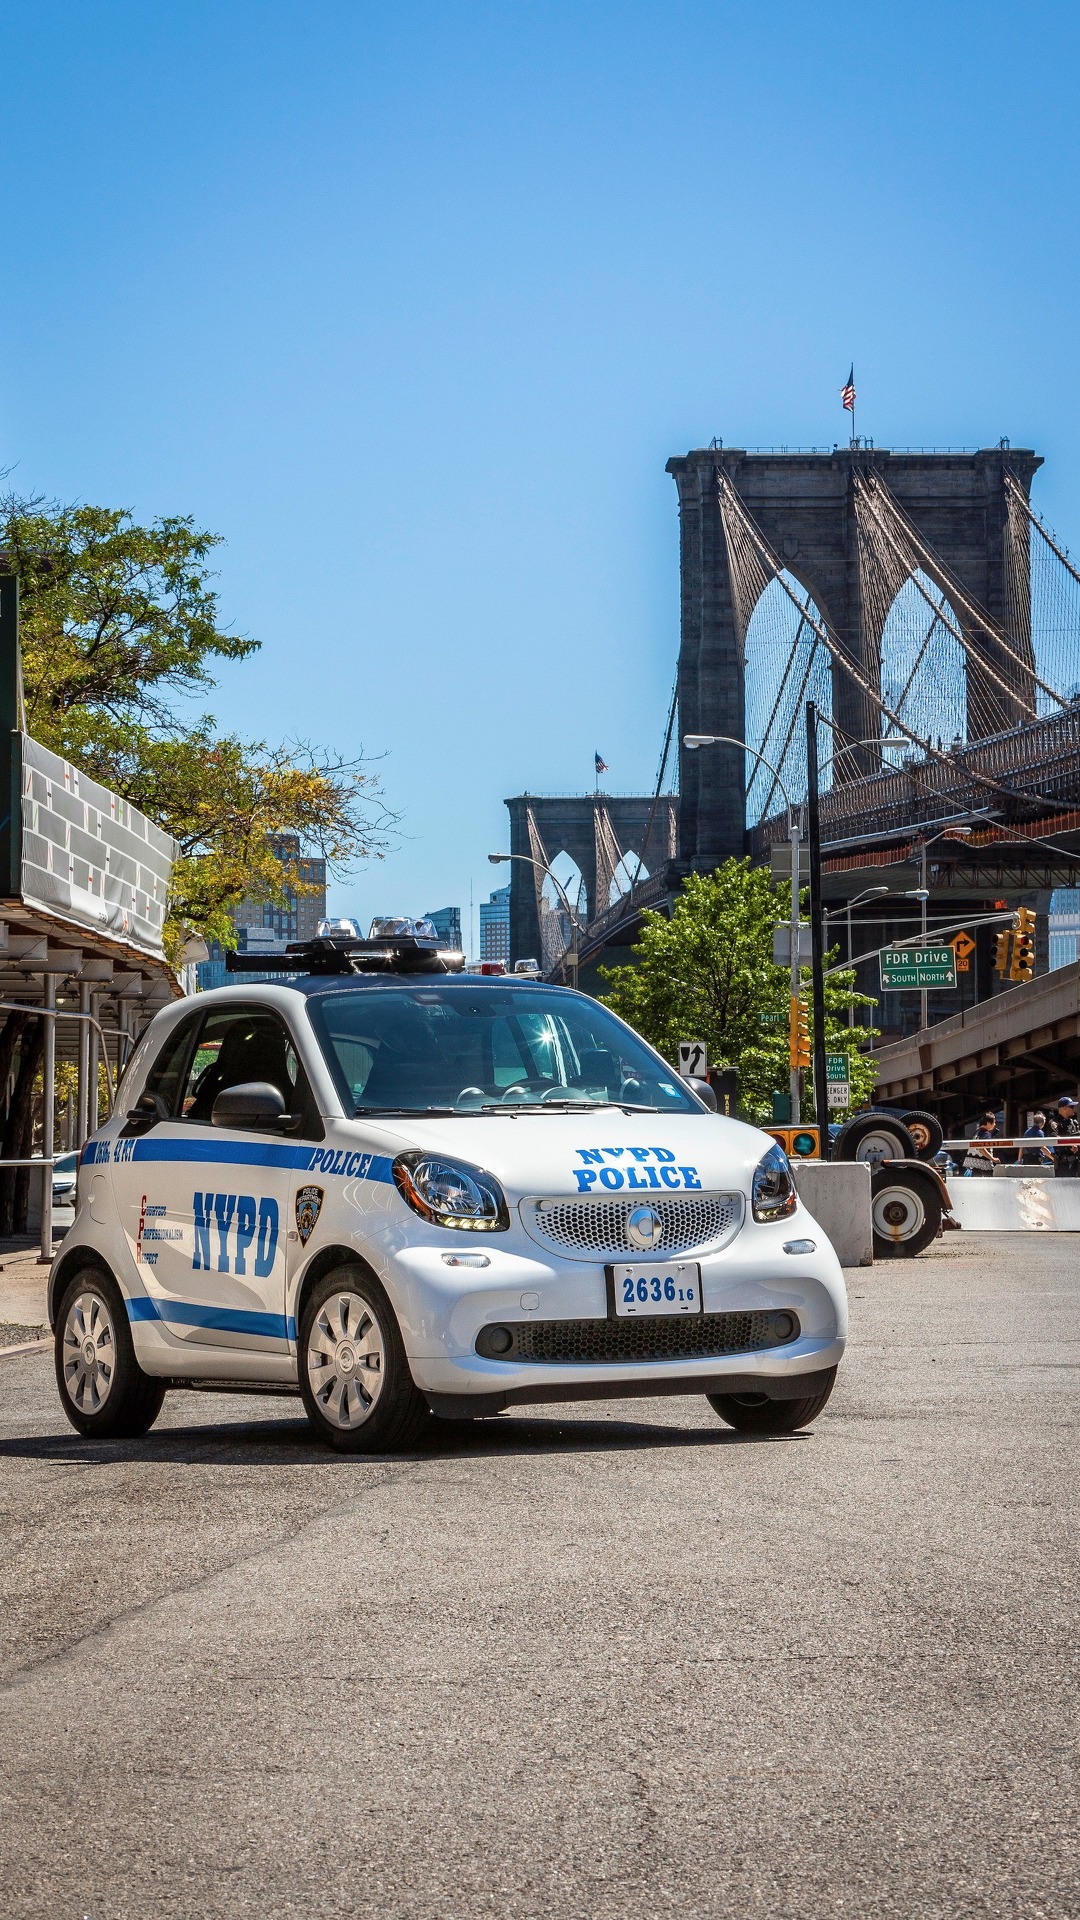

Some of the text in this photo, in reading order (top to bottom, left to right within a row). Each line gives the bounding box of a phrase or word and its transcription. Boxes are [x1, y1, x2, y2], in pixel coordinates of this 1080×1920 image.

[885, 951, 948, 964] FDR Drive
[891, 974, 916, 983] SOUTH
[920, 973, 945, 981] NORTH
[760, 1013, 780, 1022] Pearl
[827, 1086, 848, 1095] SENGER
[834, 1096, 847, 1104] ONLY
[575, 1147, 676, 1165] NYPD
[308, 1147, 373, 1179] POLICE
[572, 1166, 702, 1192] POLICE
[302, 1187, 319, 1196] POLICE
[296, 1194, 321, 1206] DEPARTMENT
[192, 1192, 279, 1278] NYPD
[623, 1277, 694, 1303] 2636 16
